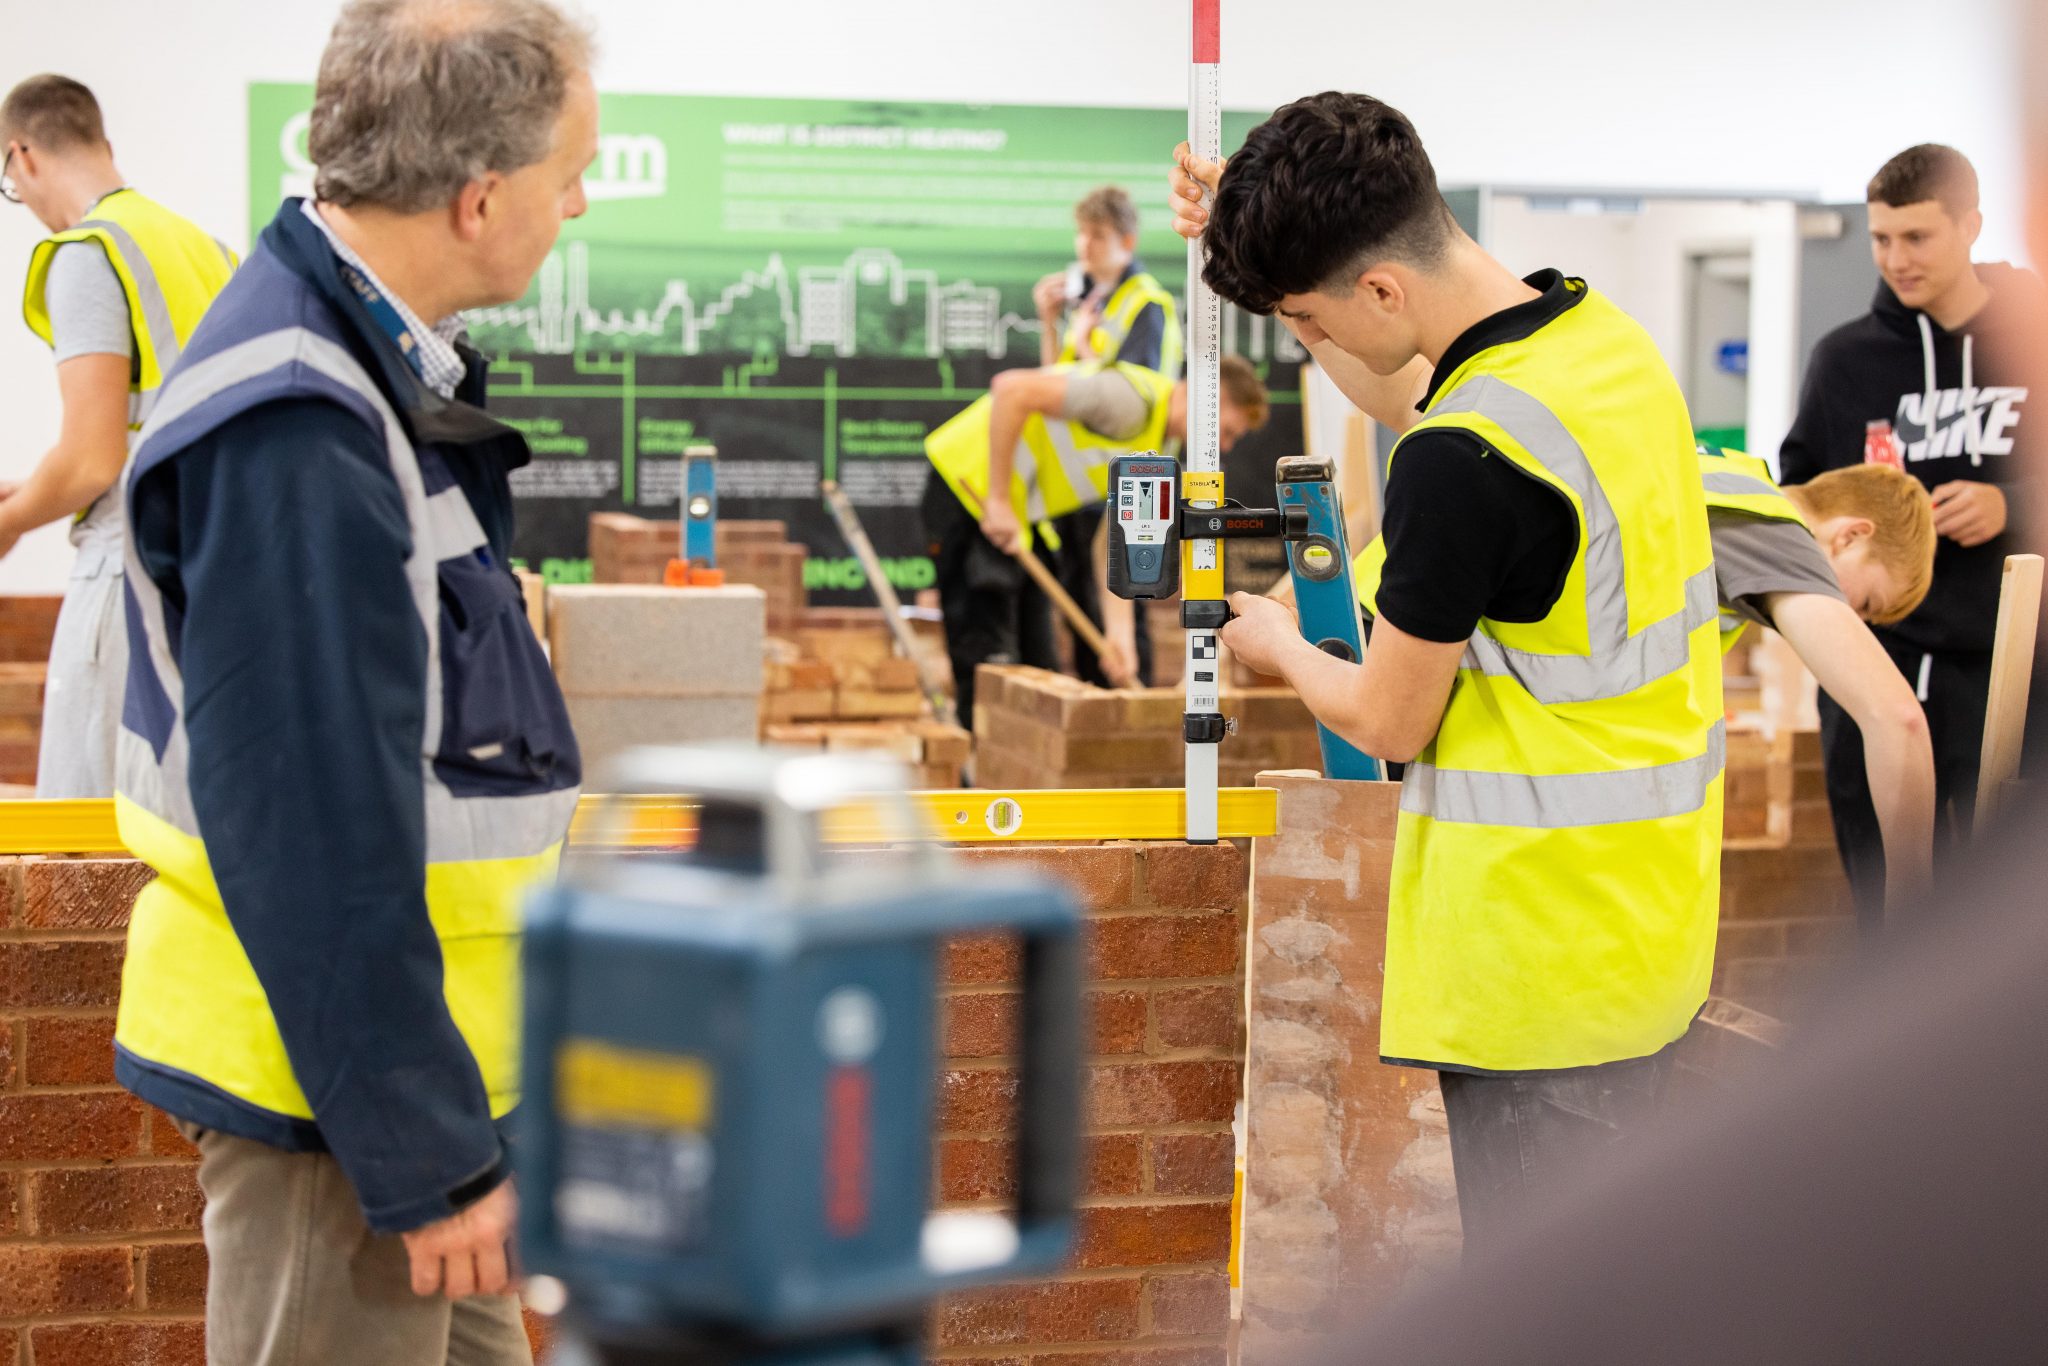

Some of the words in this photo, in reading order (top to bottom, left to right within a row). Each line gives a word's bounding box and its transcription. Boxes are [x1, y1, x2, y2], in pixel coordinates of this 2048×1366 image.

[724, 125, 785, 144] WHAT
[789, 126, 811, 146] IS
[814, 126, 904, 147] DISTRICT
[907, 128, 1006, 150] HEATING?
[1894, 387, 2029, 462] NIKE
[1128, 464, 1165, 474] BOSCH
[1226, 519, 1264, 529] BOSCH
